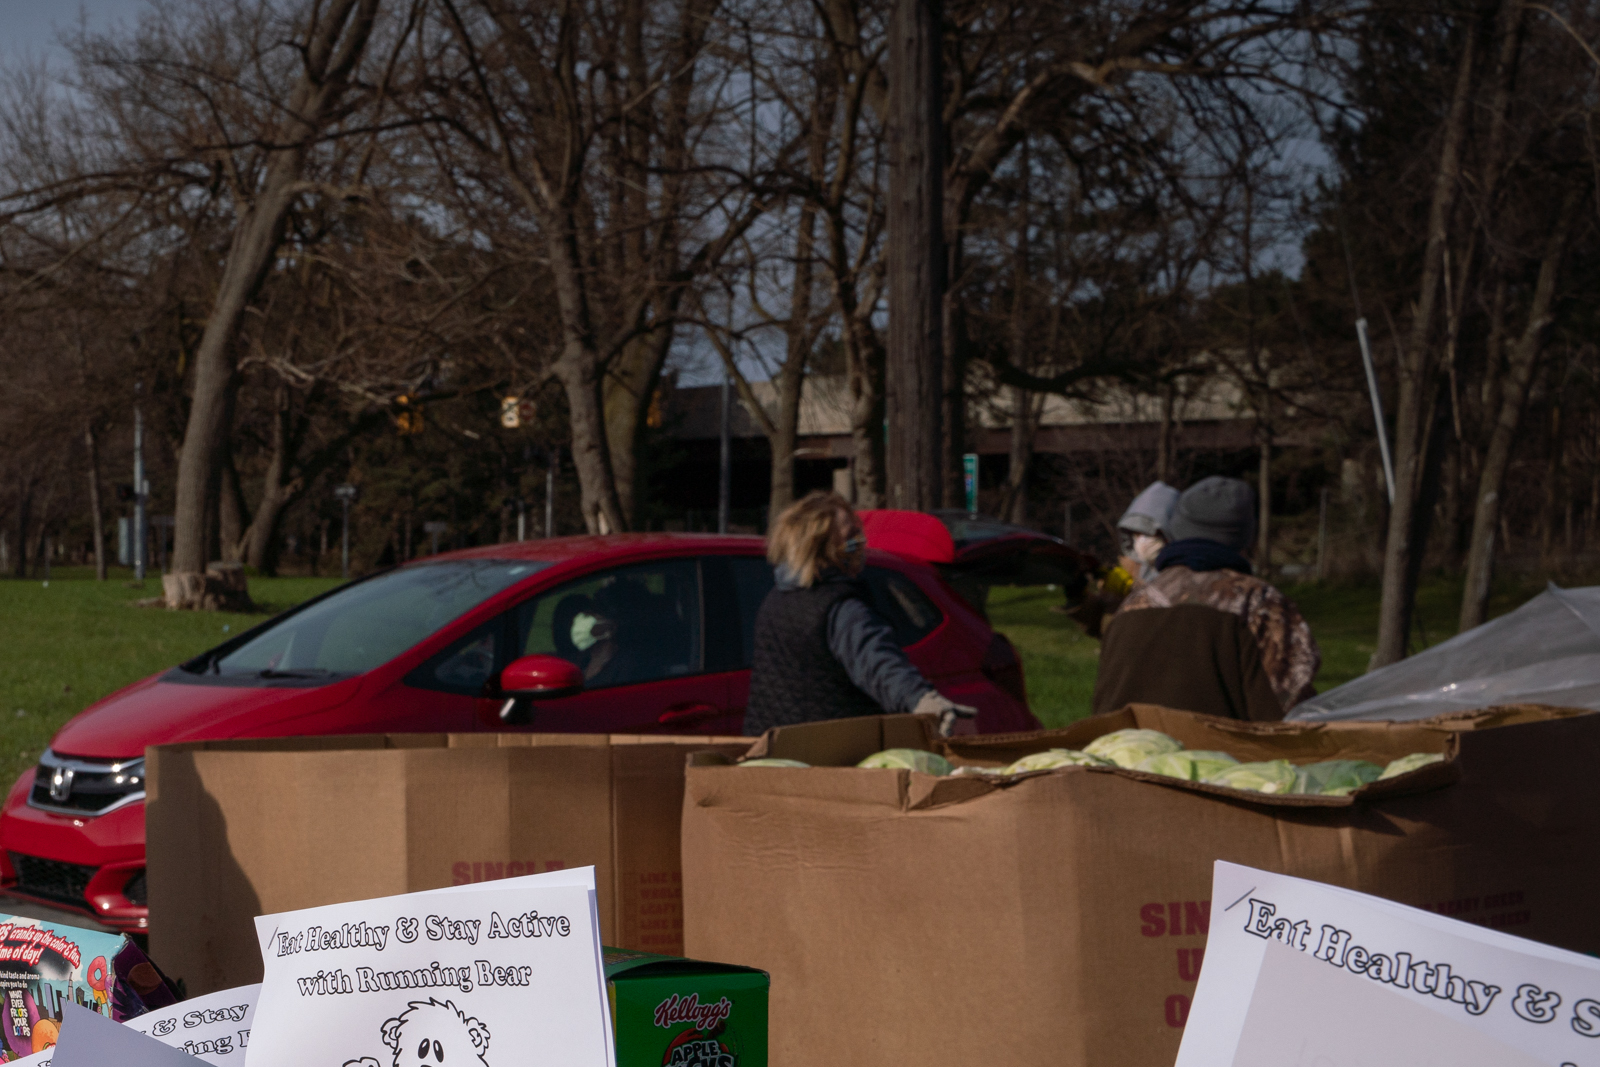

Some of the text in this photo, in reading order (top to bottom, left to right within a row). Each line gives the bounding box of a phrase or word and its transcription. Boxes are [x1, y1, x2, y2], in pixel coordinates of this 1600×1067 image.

[9, 926, 35, 942] cranks
[32, 930, 43, 946] up
[41, 930, 54, 946] the
[49, 937, 67, 955] color
[277, 911, 571, 958] Eat Healthy & Stay Active
[11, 944, 25, 961] of
[22, 946, 45, 966] day!
[8, 971, 20, 979] taste
[20, 971, 28, 979] and
[297, 960, 532, 997] with Running Bear
[1314, 924, 1502, 1015] Healthy
[1511, 984, 1563, 1023] &
[9, 990, 23, 998] WHAT
[151, 1004, 250, 1037] & Stay
[654, 993, 731, 1030] Kellogg's
[13, 1026, 31, 1036] LOOPS
[671, 1040, 720, 1067] APPLE
